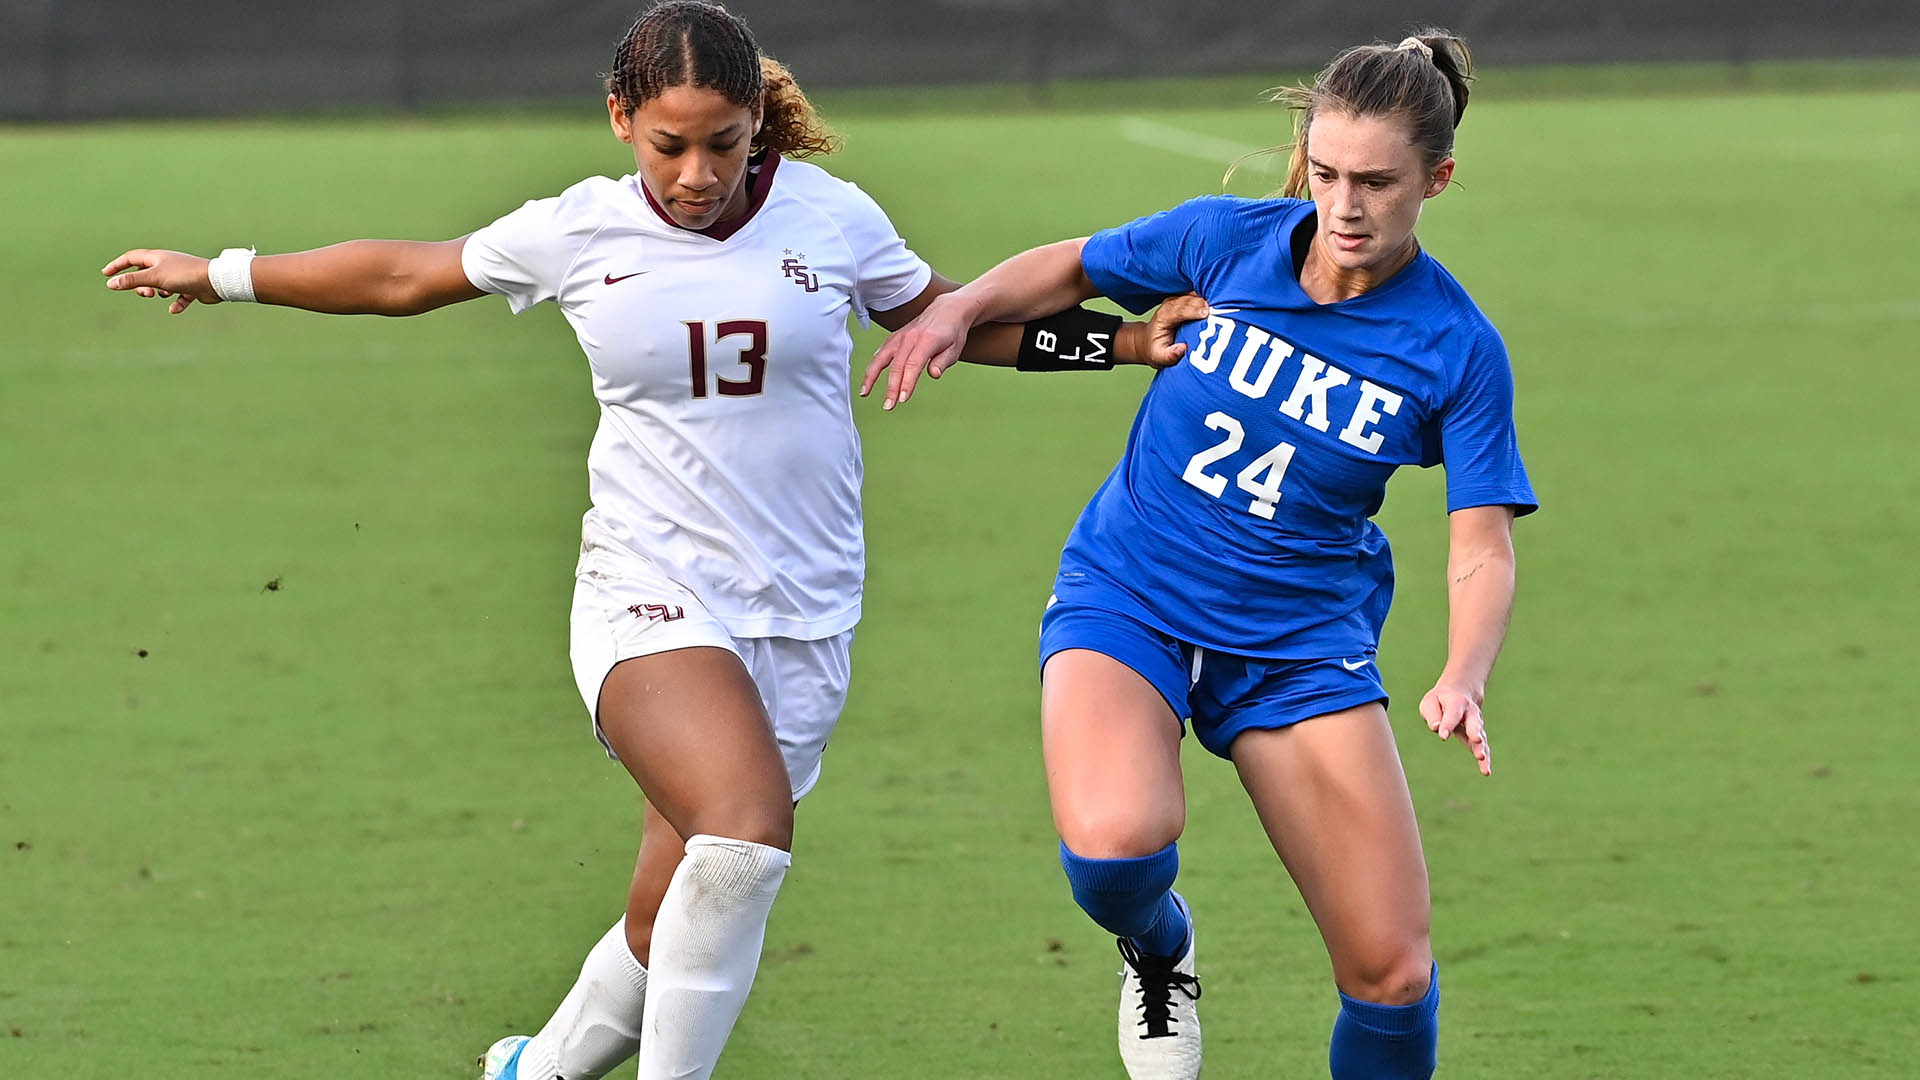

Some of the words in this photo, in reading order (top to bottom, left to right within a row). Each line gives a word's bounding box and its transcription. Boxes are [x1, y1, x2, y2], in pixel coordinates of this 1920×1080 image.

[781, 259, 819, 292] FSU
[680, 319, 768, 399] 13
[1035, 330, 1110, 363] BLM
[1189, 314, 1403, 455] DUKE
[1182, 410, 1297, 520] 24
